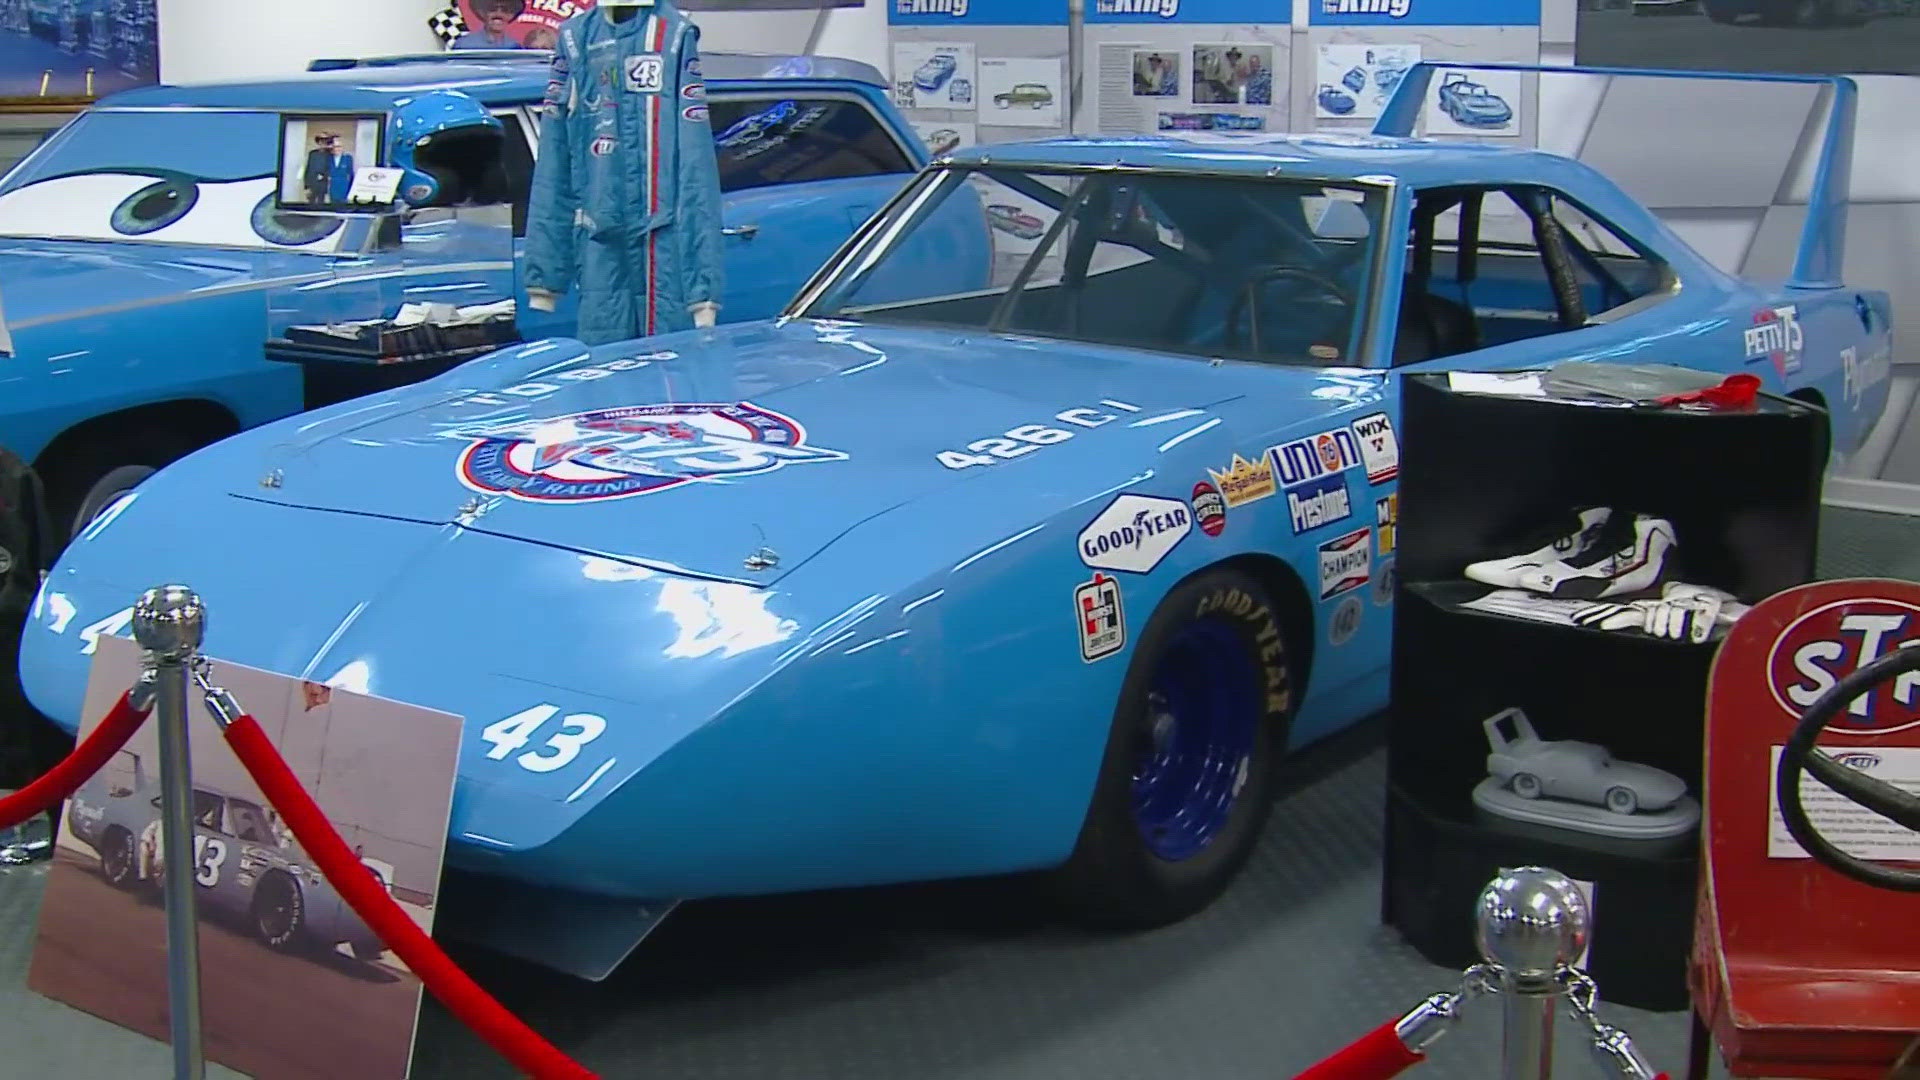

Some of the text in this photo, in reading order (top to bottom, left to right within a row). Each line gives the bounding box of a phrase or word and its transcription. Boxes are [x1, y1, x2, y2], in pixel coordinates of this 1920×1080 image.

[630, 59, 662, 88] 43
[1744, 323, 1784, 357] PETTY
[1356, 418, 1390, 438] WIX
[935, 424, 1076, 470] 426
[1288, 488, 1351, 532] Prestone
[1324, 547, 1369, 580] CHAMPION
[482, 702, 608, 772] 43
